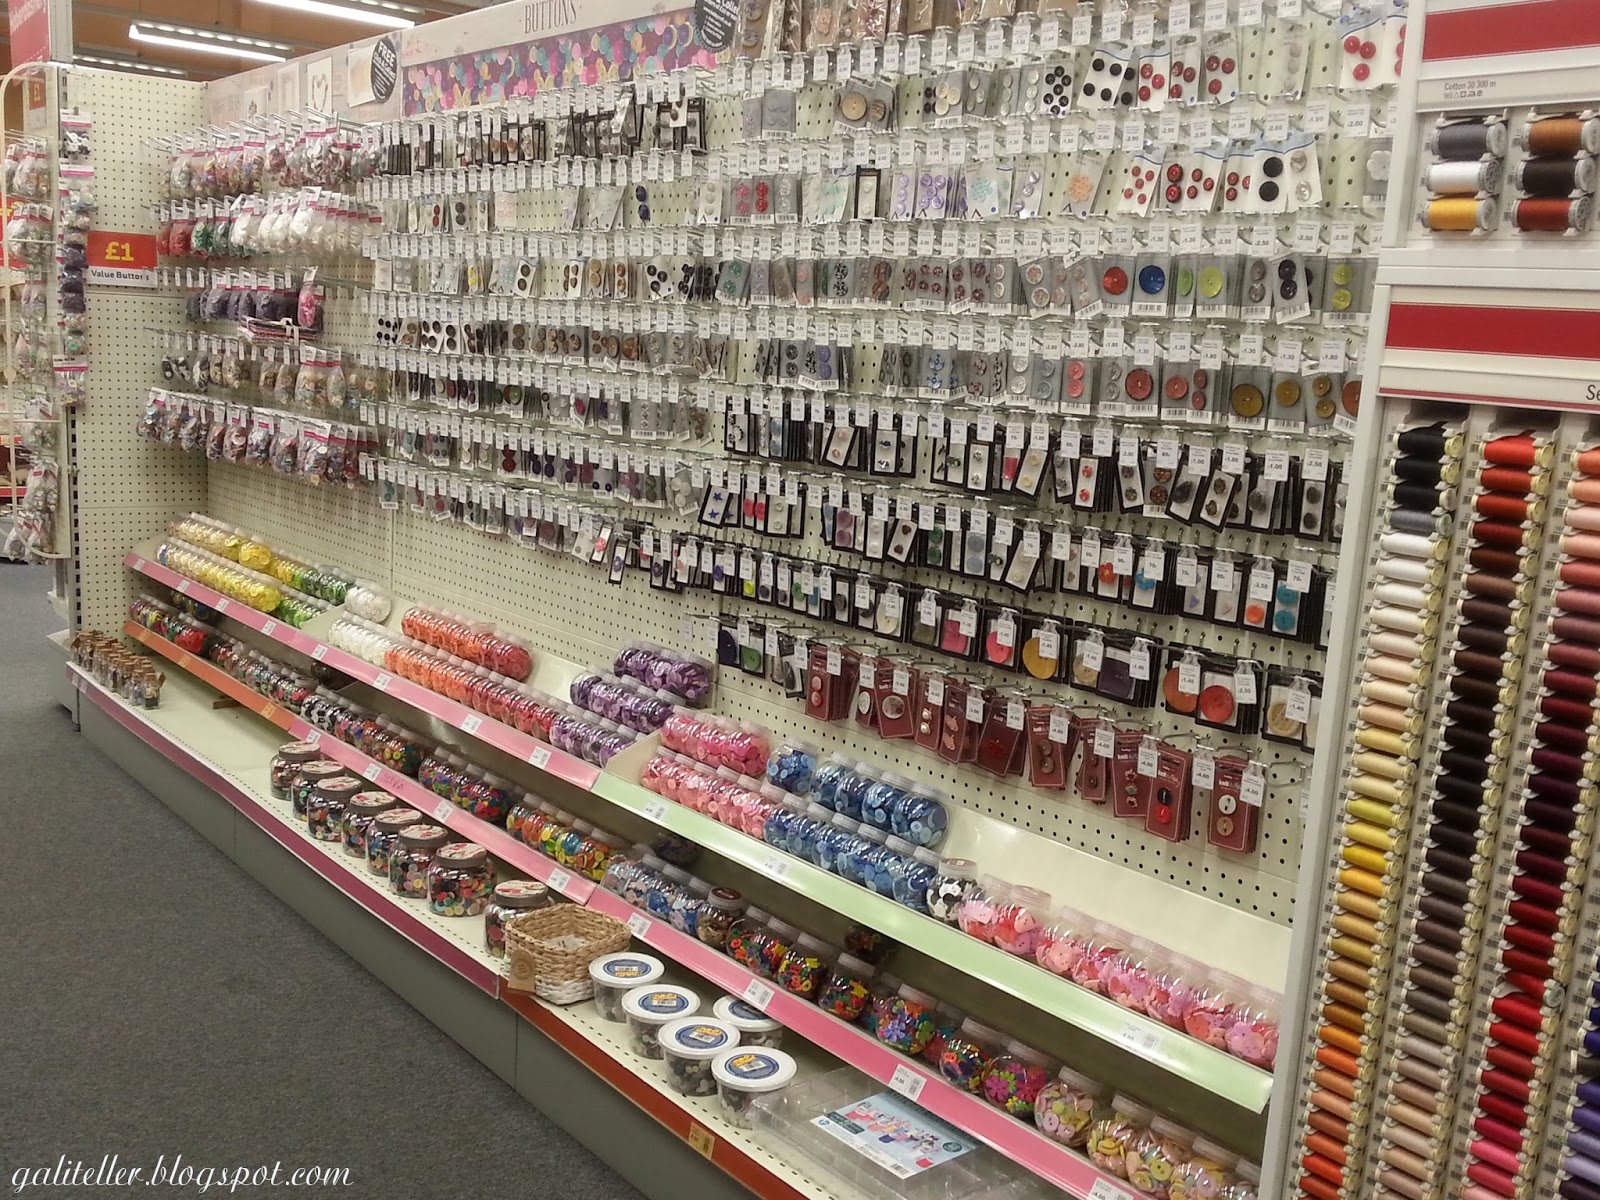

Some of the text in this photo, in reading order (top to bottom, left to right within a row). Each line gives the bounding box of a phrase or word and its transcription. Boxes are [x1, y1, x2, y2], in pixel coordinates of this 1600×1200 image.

[524, 0, 576, 34] BUTTONS
[378, 41, 396, 68] FREE
[1444, 82, 1466, 90] Cotton
[1476, 80, 1488, 88] 300
[106, 242, 134, 262] £1
[91, 270, 114, 279] Value
